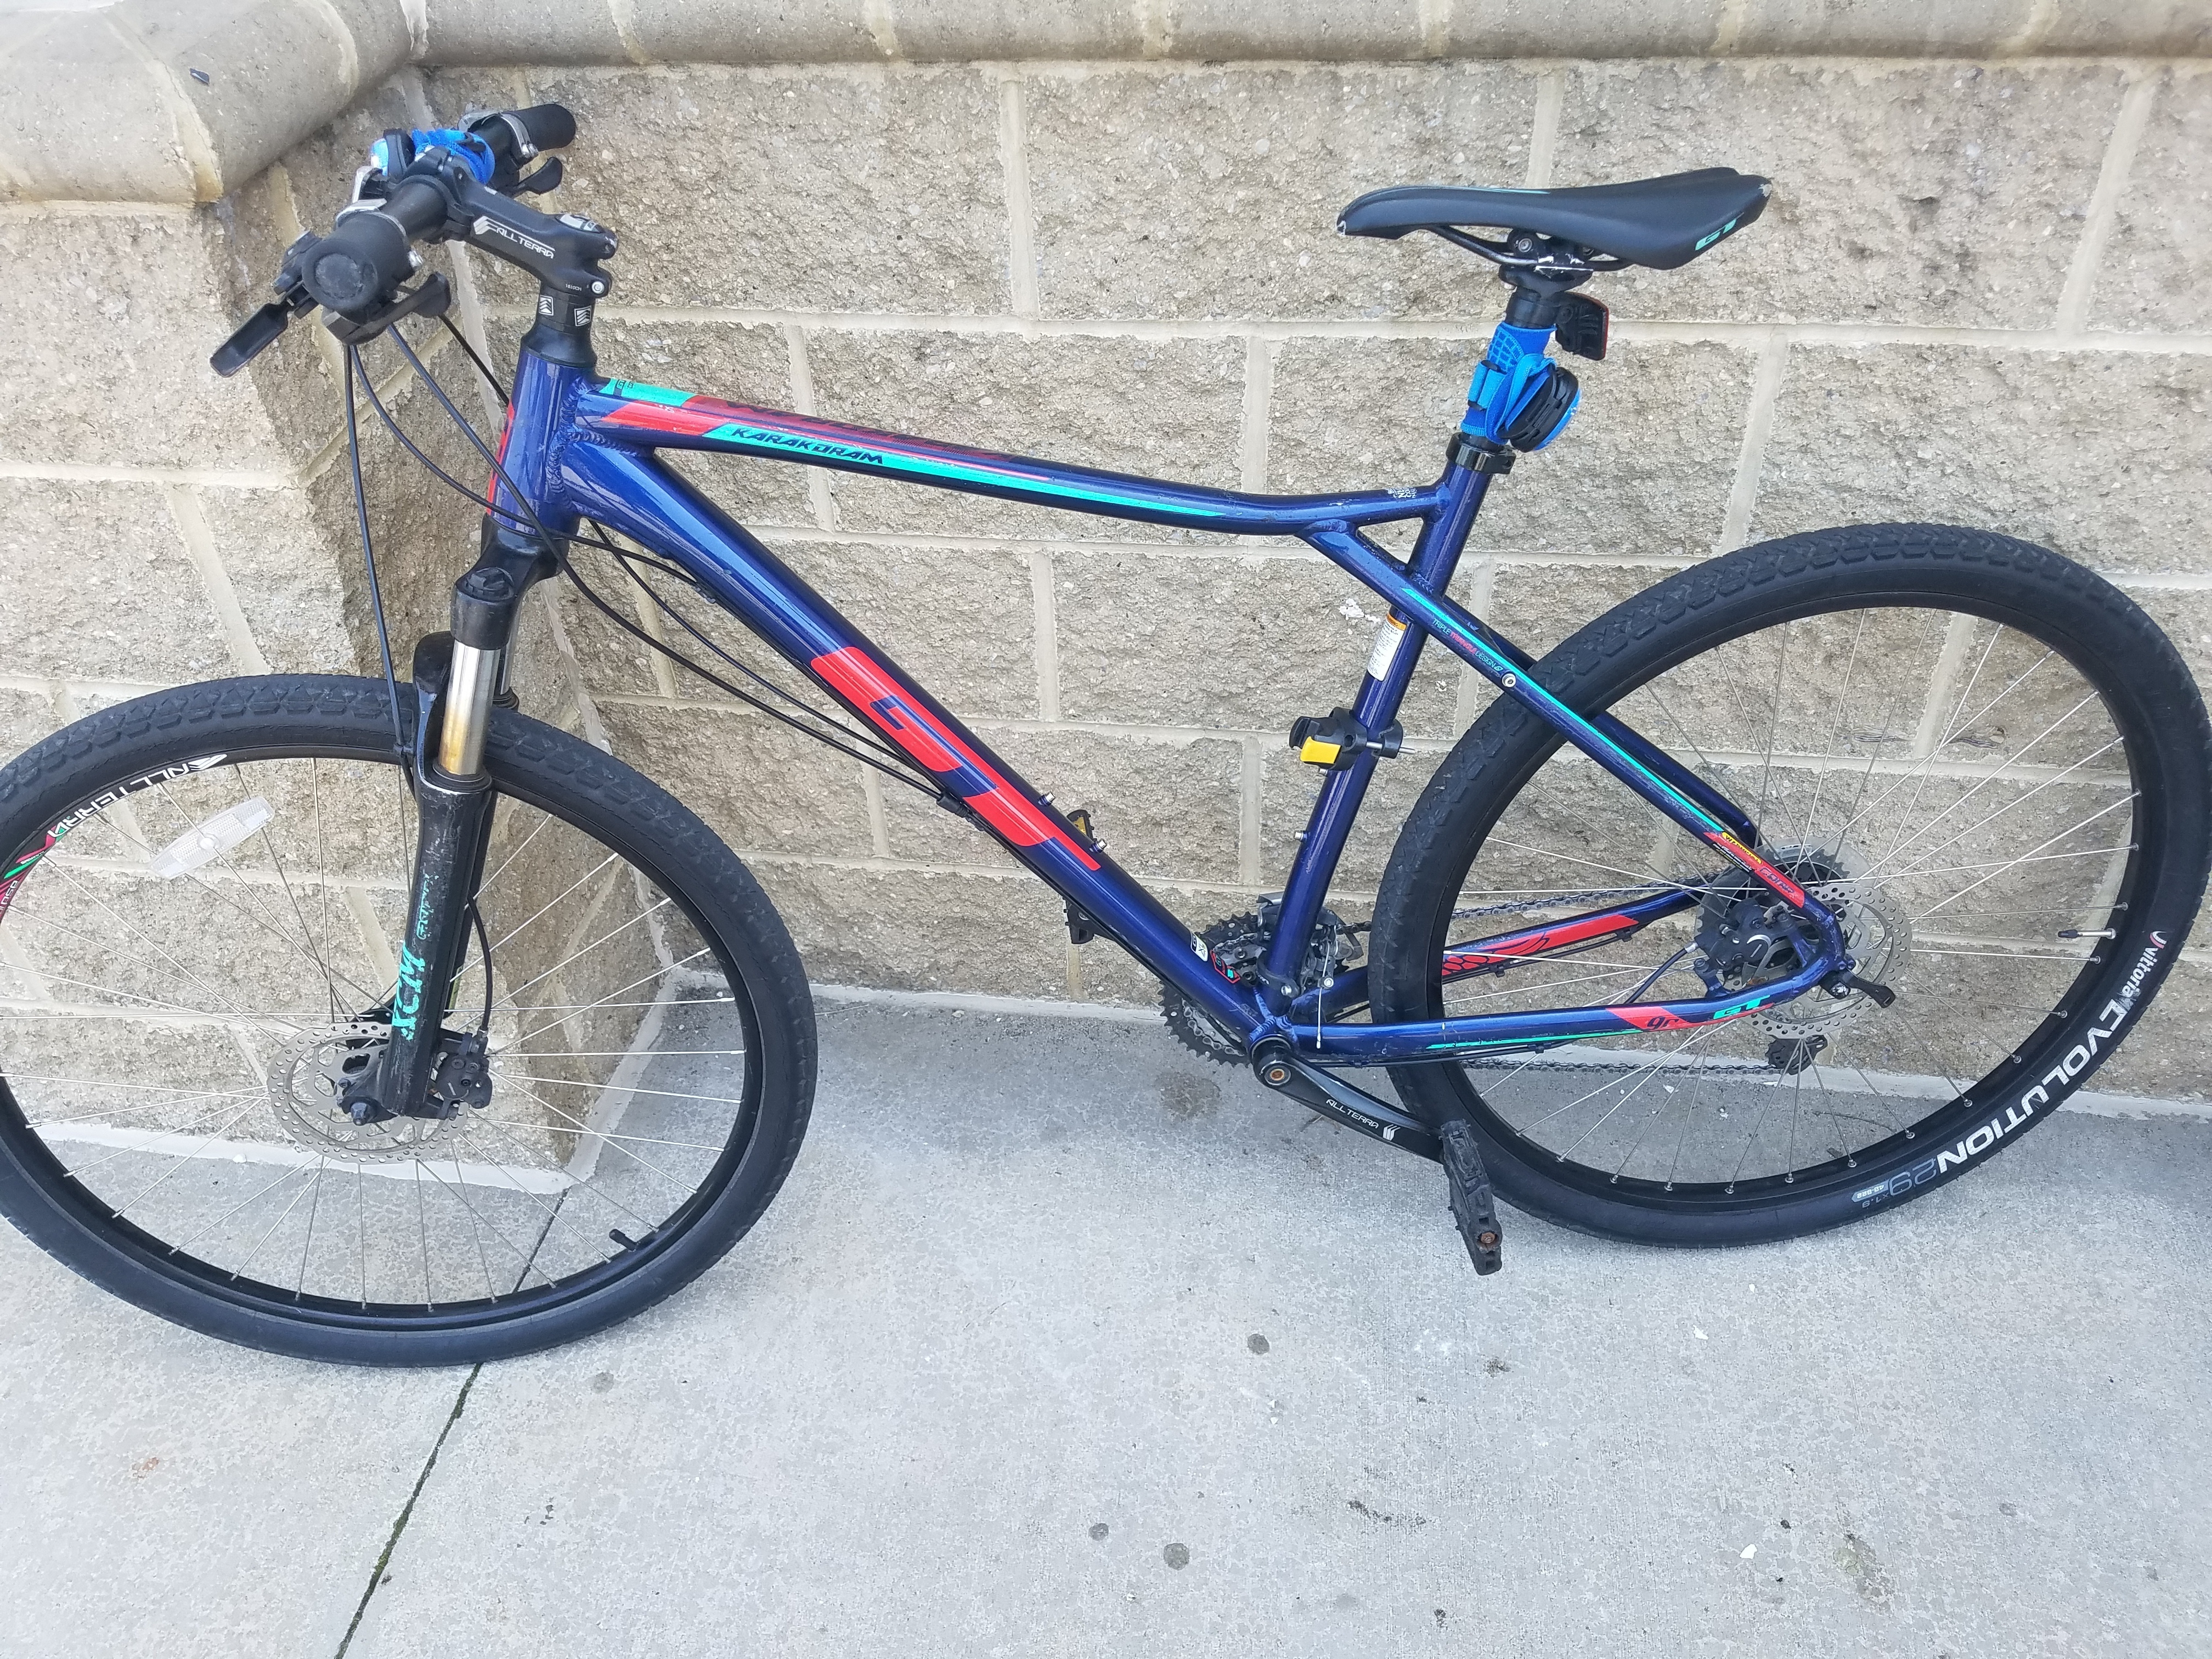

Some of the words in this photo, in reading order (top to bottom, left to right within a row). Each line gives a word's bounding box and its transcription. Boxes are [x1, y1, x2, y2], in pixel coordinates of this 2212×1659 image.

[496, 227, 518, 242] ALL
[518, 236, 554, 259] TERRA
[1695, 212, 1744, 251] GT
[730, 427, 884, 464] KARAKORAM
[1432, 618, 1451, 635] TRIPLE
[1475, 650, 1497, 668] DESIGN
[130, 763, 190, 786] ALL
[810, 646, 1102, 871] GT
[47, 786, 137, 838] TERRA
[2121, 946, 2159, 998] vittoria
[1713, 995, 1770, 1019] GT
[1936, 998, 2128, 1173] EVOLUTION
[1325, 1099, 1346, 1113] ALL
[1347, 1108, 1379, 1129] TERRA
[1889, 1158, 1937, 1196] 29
